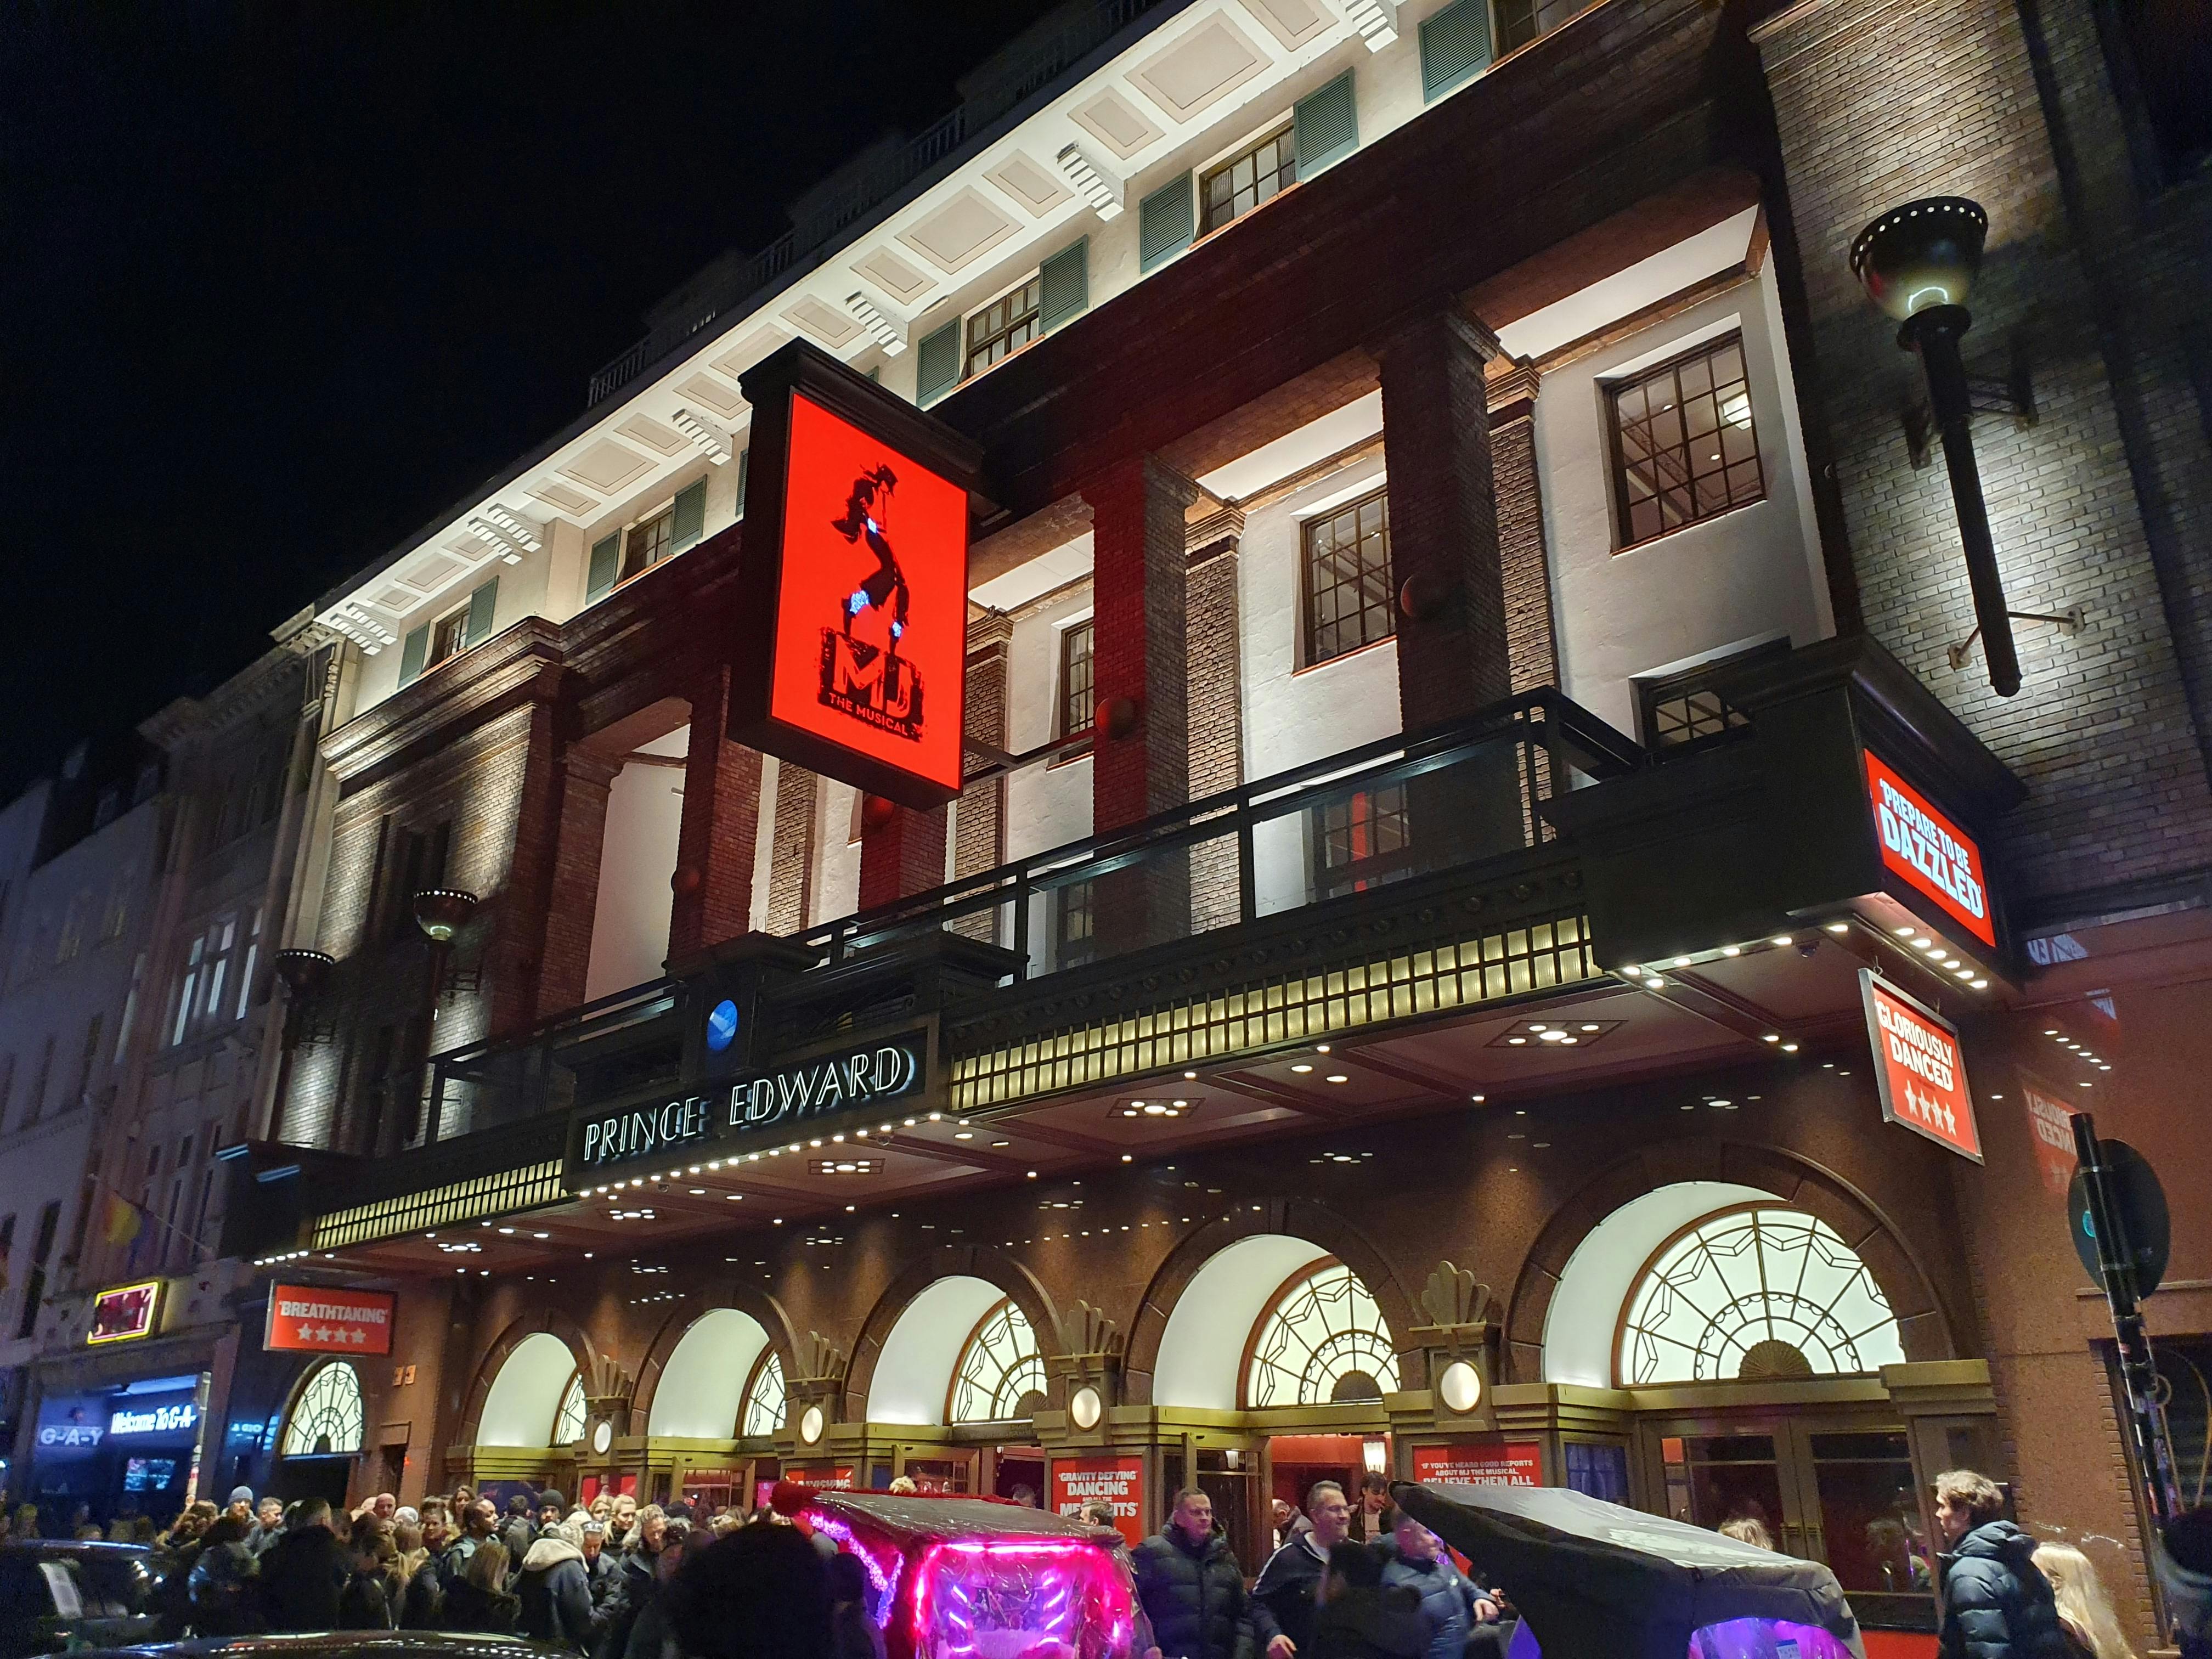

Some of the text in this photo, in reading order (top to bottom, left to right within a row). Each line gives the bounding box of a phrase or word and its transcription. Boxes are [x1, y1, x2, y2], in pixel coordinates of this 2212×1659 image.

[829, 692, 908, 736] THE MUSICAL
[1937, 827, 1955, 861] TO
[1954, 842, 1972, 876] BE
[584, 1047, 902, 1161] PRINCE EDWARD
[111, 1412, 156, 1434] Welcome
[155, 1407, 169, 1430] To
[41, 1427, 104, 1446] G-A-Y
[1067, 1481, 1128, 1496] DANCING
[1473, 1476, 1508, 1486] THEM
[1511, 1475, 1534, 1486] ALL
